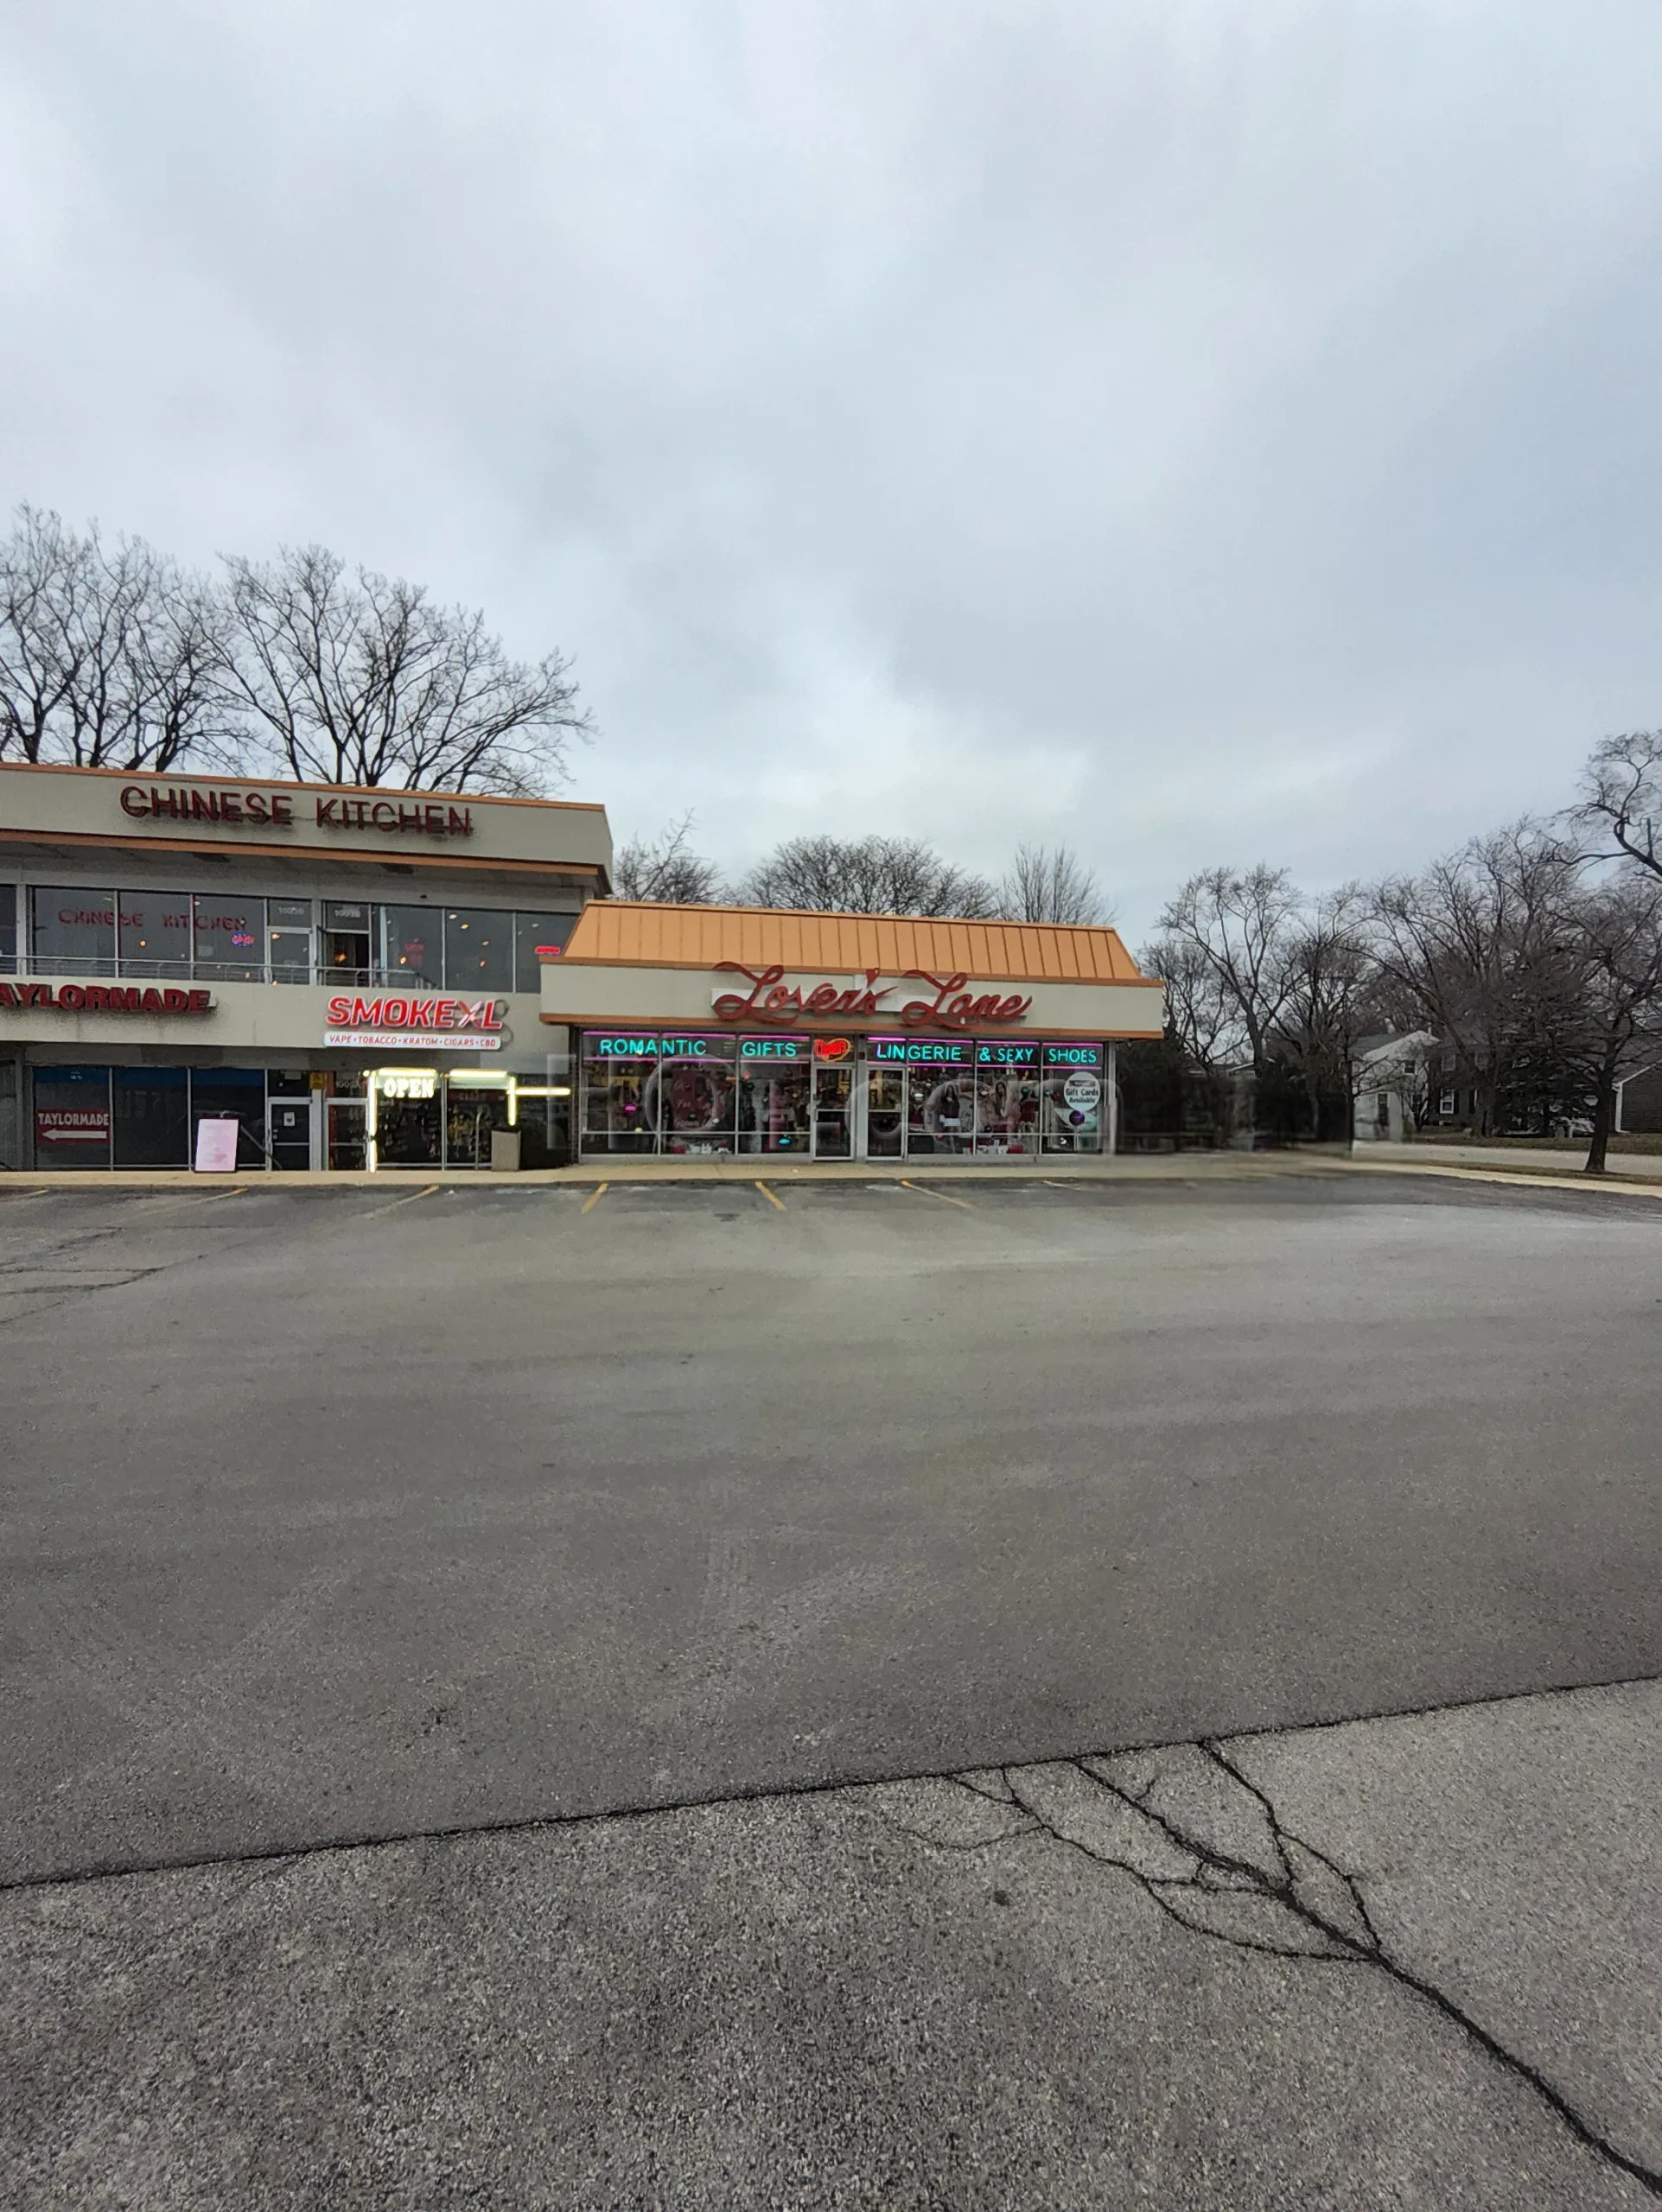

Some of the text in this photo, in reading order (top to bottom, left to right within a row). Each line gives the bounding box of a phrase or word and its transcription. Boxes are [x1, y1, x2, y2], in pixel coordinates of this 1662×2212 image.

[120, 786, 473, 836] CHINESE KITCHEN
[58, 909, 144, 928] CHINESE
[711, 960, 1034, 1030] Lover's Lane
[329, 1035, 352, 1044] VAPE
[358, 1036, 398, 1045] TOBACCO
[599, 1039, 1098, 1064] ROMANTIC GIFTS LINGERIE & SEXY SHOES
[383, 1077, 436, 1098] OPEN
[1066, 1088, 1099, 1096] Gift Cards
[37, 1112, 110, 1127] TAYLORMADE
